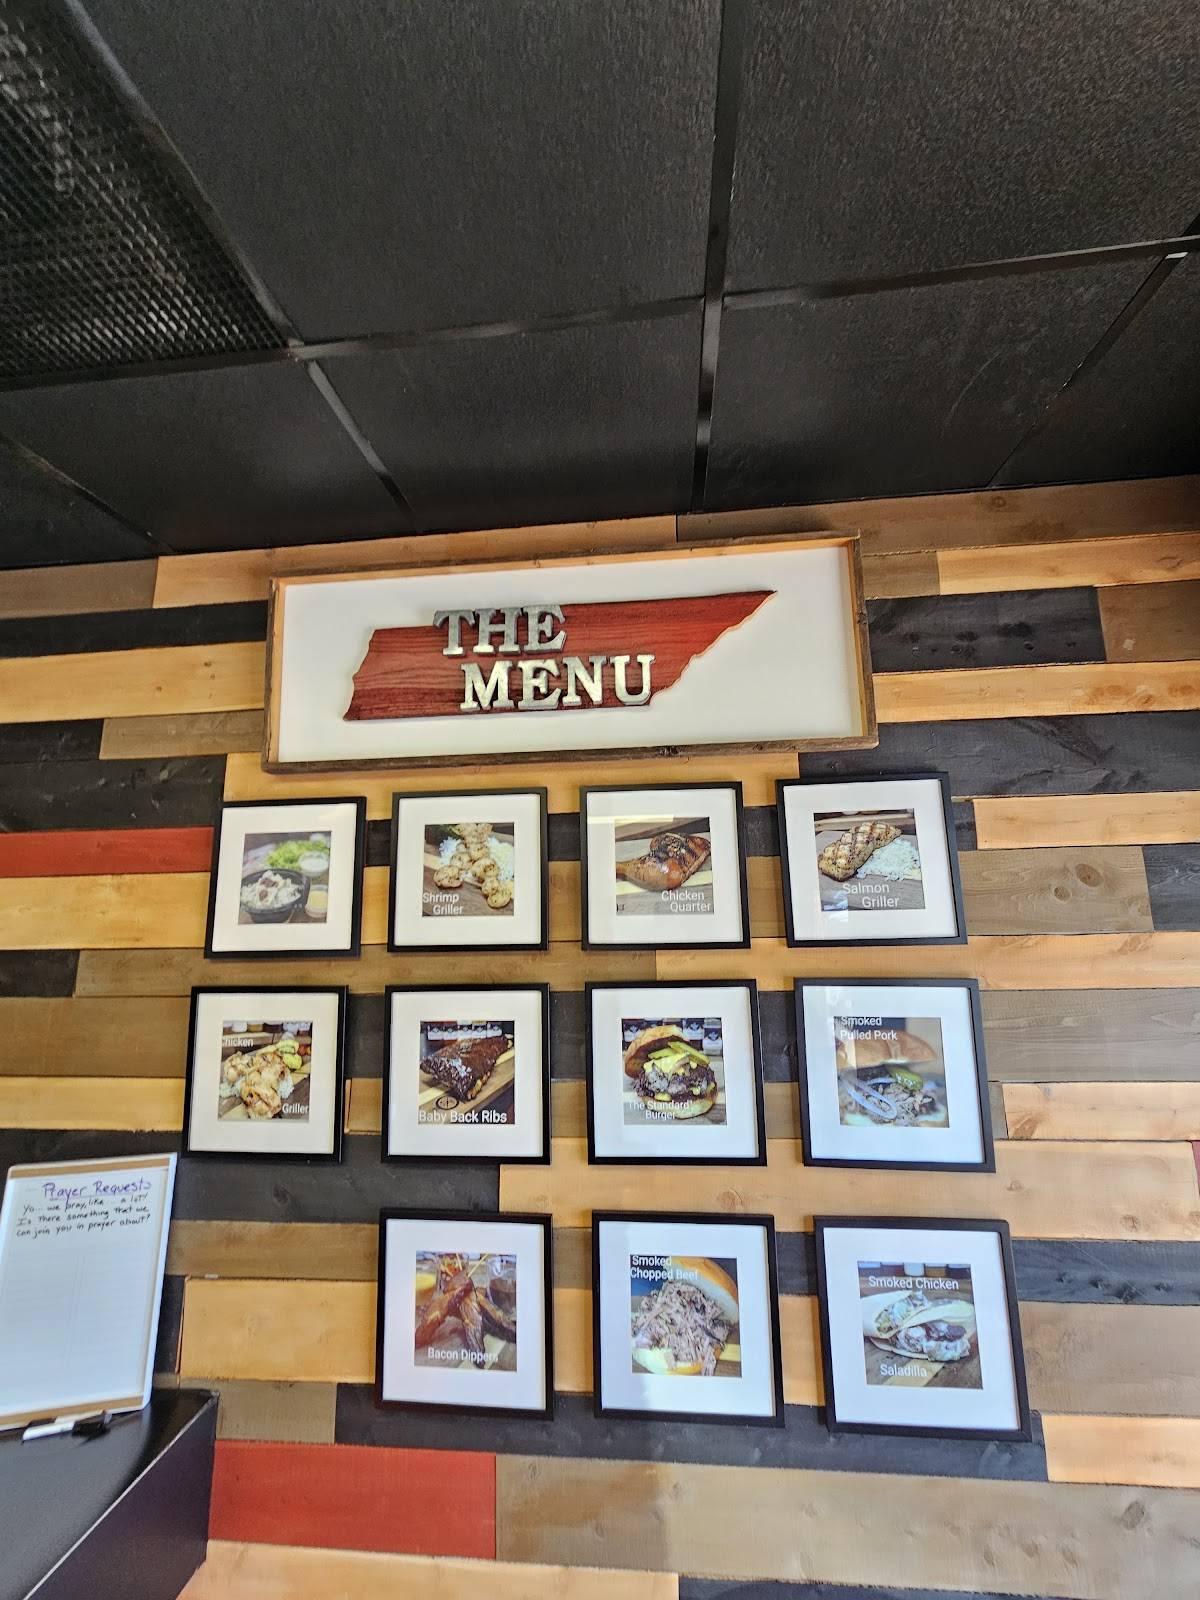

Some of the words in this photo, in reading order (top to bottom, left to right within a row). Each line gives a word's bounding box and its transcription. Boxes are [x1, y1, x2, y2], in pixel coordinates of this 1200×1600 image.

[433, 604, 567, 656] THE
[460, 653, 656, 712] MENU
[842, 882, 890, 894] Salmon
[422, 892, 460, 905] Shrimp
[661, 890, 705, 901] Chicken
[670, 902, 712, 913] Quarter
[862, 897, 899, 908] Griller
[433, 904, 464, 915] Griller
[840, 1016, 883, 1026] Smoked
[840, 1030, 871, 1040] Pulled
[874, 1030, 898, 1041] Pork
[282, 1103, 309, 1114] Griller
[628, 1101, 645, 1110] The
[419, 1111, 447, 1124] Baby
[450, 1110, 479, 1123] Back
[482, 1109, 508, 1123] Ribs
[645, 1111, 676, 1121] Burger
[42, 1182, 88, 1203] Prayer
[93, 1177, 152, 1196] Requests
[67, 1210, 109, 1221] something
[114, 1206, 132, 1214] that
[16, 1229, 31, 1238] can
[34, 1225, 50, 1239] join
[56, 1225, 72, 1235] you
[88, 1219, 115, 1232] prayer
[631, 1255, 672, 1266] Smoked
[630, 1266, 674, 1282] Chopped
[868, 1275, 913, 1288] Smoked
[915, 1276, 960, 1290] Chicken
[427, 1347, 459, 1360] Bacon
[461, 1349, 499, 1364] Dippers
[880, 1364, 928, 1377] Saladilla
